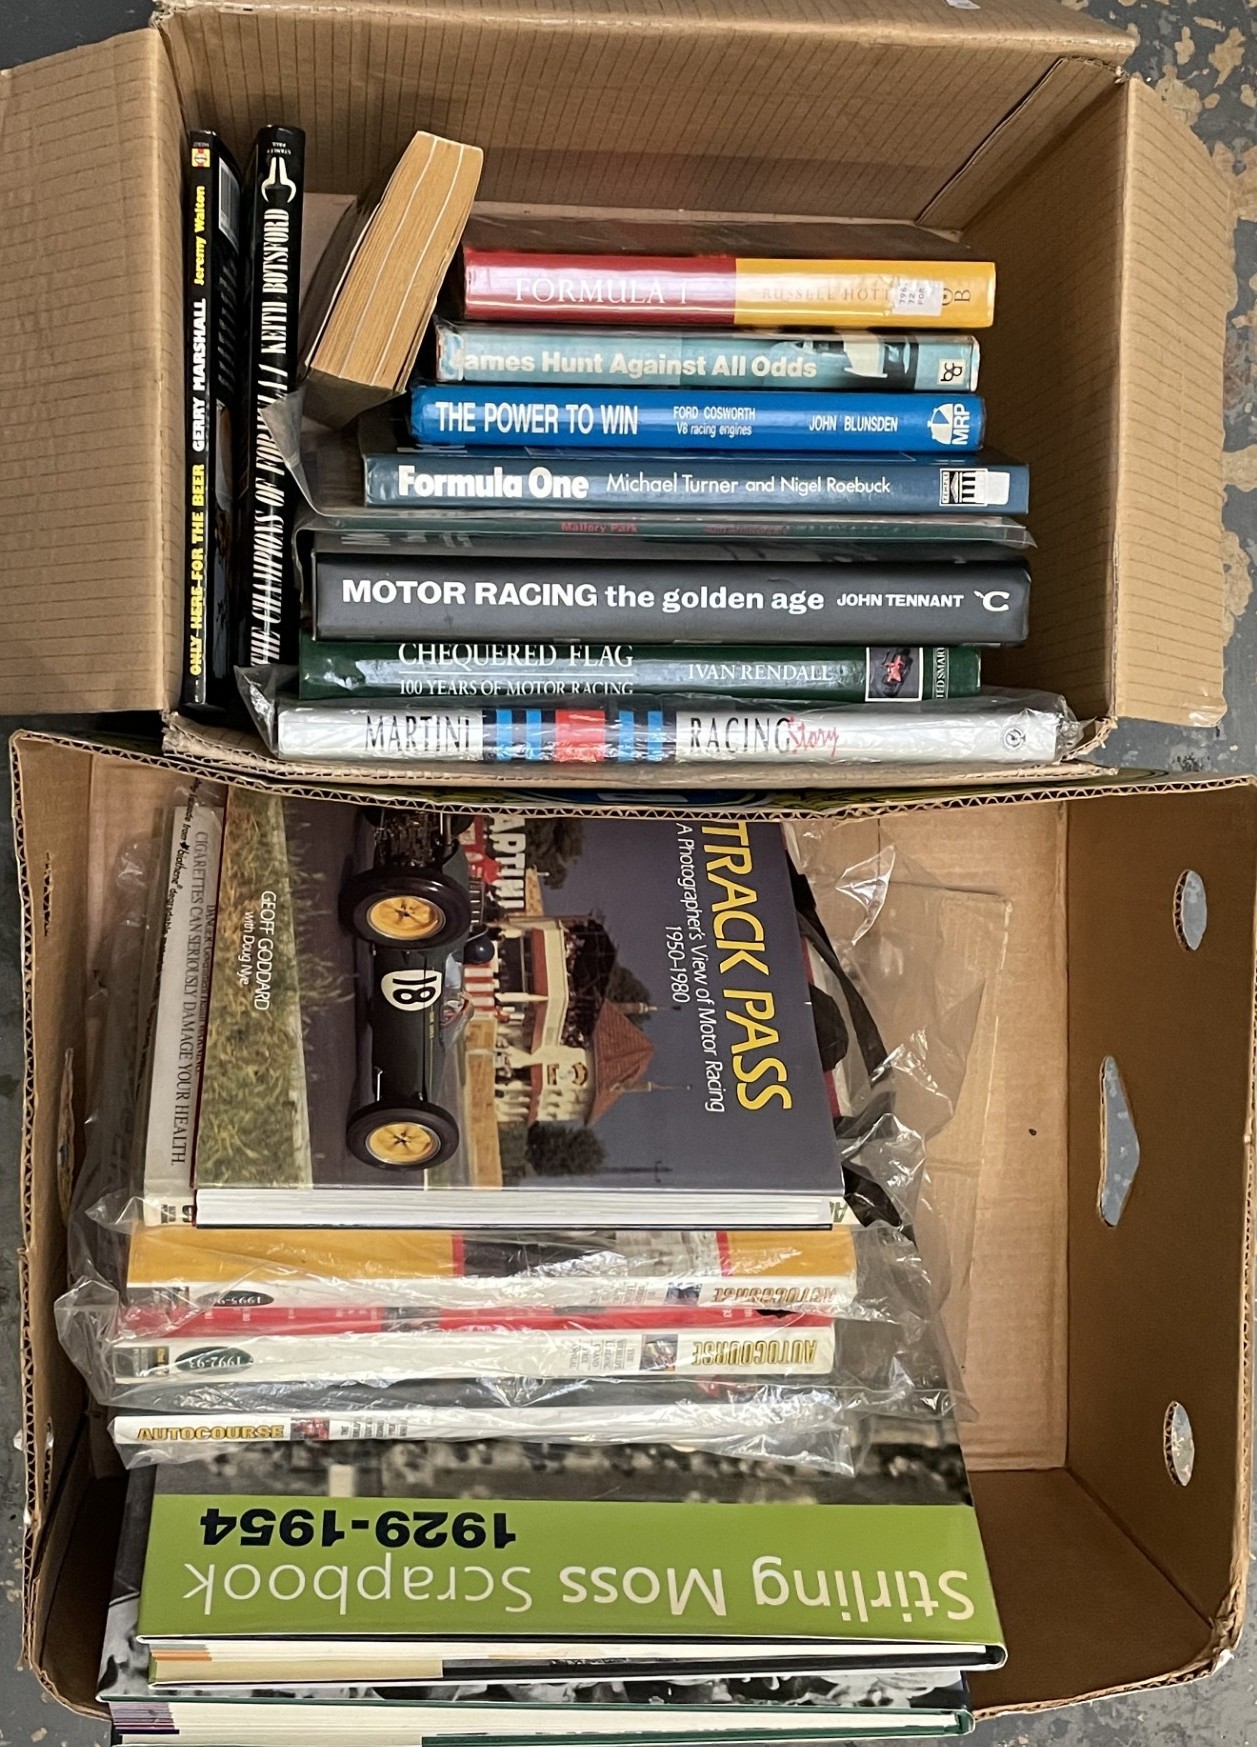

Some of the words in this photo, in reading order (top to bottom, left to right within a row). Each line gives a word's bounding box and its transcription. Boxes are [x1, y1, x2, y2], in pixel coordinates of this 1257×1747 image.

[194, 186, 205, 233] Walton
[194, 236, 207, 286] Jeremy
[262, 208, 289, 294] BOTSFORD
[515, 278, 665, 304] FORMULA
[679, 282, 687, 304] 1
[762, 288, 834, 300] RUSSELL
[192, 298, 206, 391] MARSHALL
[261, 301, 287, 354] KEITH
[542, 351, 603, 373] Hunt
[609, 353, 706, 379] Against
[711, 355, 746, 377] All
[751, 355, 817, 378] Odds
[192, 397, 205, 452] GERRY
[436, 402, 476, 432] THE
[484, 403, 559, 434] POWER
[566, 404, 594, 434] TO
[601, 405, 638, 435] WIN
[673, 406, 698, 419] FORD
[704, 406, 756, 421] COSWORTH
[677, 422, 688, 434] V8
[690, 422, 716, 438] racing
[719, 424, 752, 438] engines
[809, 415, 837, 431] JOHN
[844, 416, 898, 432] BLUNSDEN
[951, 403, 970, 445] MRP
[192, 464, 204, 507] BEER
[255, 477, 285, 507] OF
[398, 465, 524, 497] Formula
[528, 467, 589, 498] One
[606, 471, 678, 493] Michael
[682, 473, 739, 493] Turner
[746, 477, 775, 493] and
[780, 477, 822, 497] Nigel
[827, 477, 891, 494] Roebuck
[191, 512, 204, 544] THE
[561, 522, 606, 534] Mallory
[611, 522, 638, 533] Park
[191, 548, 203, 580] FOR
[252, 509, 284, 624] CHAMPIONS
[190, 586, 203, 629] HERE
[342, 579, 467, 604] MOTOR
[475, 582, 597, 607] RACING
[604, 585, 655, 608] the
[662, 586, 769, 613] golden
[771, 590, 825, 615] age
[836, 593, 882, 607] JOHN
[885, 594, 964, 608] TENNANT
[190, 635, 202, 676] ONLY
[398, 643, 557, 672] CHEQUERED
[568, 645, 634, 668] FLAG
[688, 664, 736, 680] IVAN
[741, 664, 833, 681] RENDALL
[399, 680, 423, 696] 100
[426, 680, 477, 696] YEARS
[481, 681, 502, 696] OF
[504, 681, 565, 696] MOTOR
[572, 682, 634, 696] RACING
[365, 714, 470, 751] MARTINI
[690, 717, 791, 754] RACING
[676, 823, 693, 835] A
[189, 832, 208, 904] CIGARETTES
[489, 816, 526, 910] ARTINI
[677, 838, 706, 941] Photographer's
[701, 820, 770, 976] TRACK
[188, 906, 203, 936] CAN
[245, 911, 254, 931] with
[260, 890, 277, 936] GEOFF
[183, 936, 202, 996] SERIOUSLY
[238, 932, 255, 962] Doug
[665, 926, 691, 1003] 1950-1980
[691, 944, 709, 985] View
[237, 964, 253, 986] Nye
[254, 938, 276, 1010] GODDARD
[392, 976, 438, 1005] 18
[695, 989, 715, 1005] of
[178, 1002, 197, 1060] DAMAGE
[698, 1007, 718, 1056] Motor
[723, 989, 793, 1111] PASS
[175, 1064, 192, 1101] YOUR
[705, 1060, 727, 1113] Racing
[189, 1355, 242, 1369] 1992-93
[692, 1340, 818, 1365] AUTOCOURSE
[136, 1425, 285, 1441] AUTOCOURSE
[201, 1508, 517, 1550] 1929-1954
[182, 1552, 533, 1615] Scrapbook
[559, 1565, 727, 1617] Moss
[753, 1555, 976, 1623] Stirling
